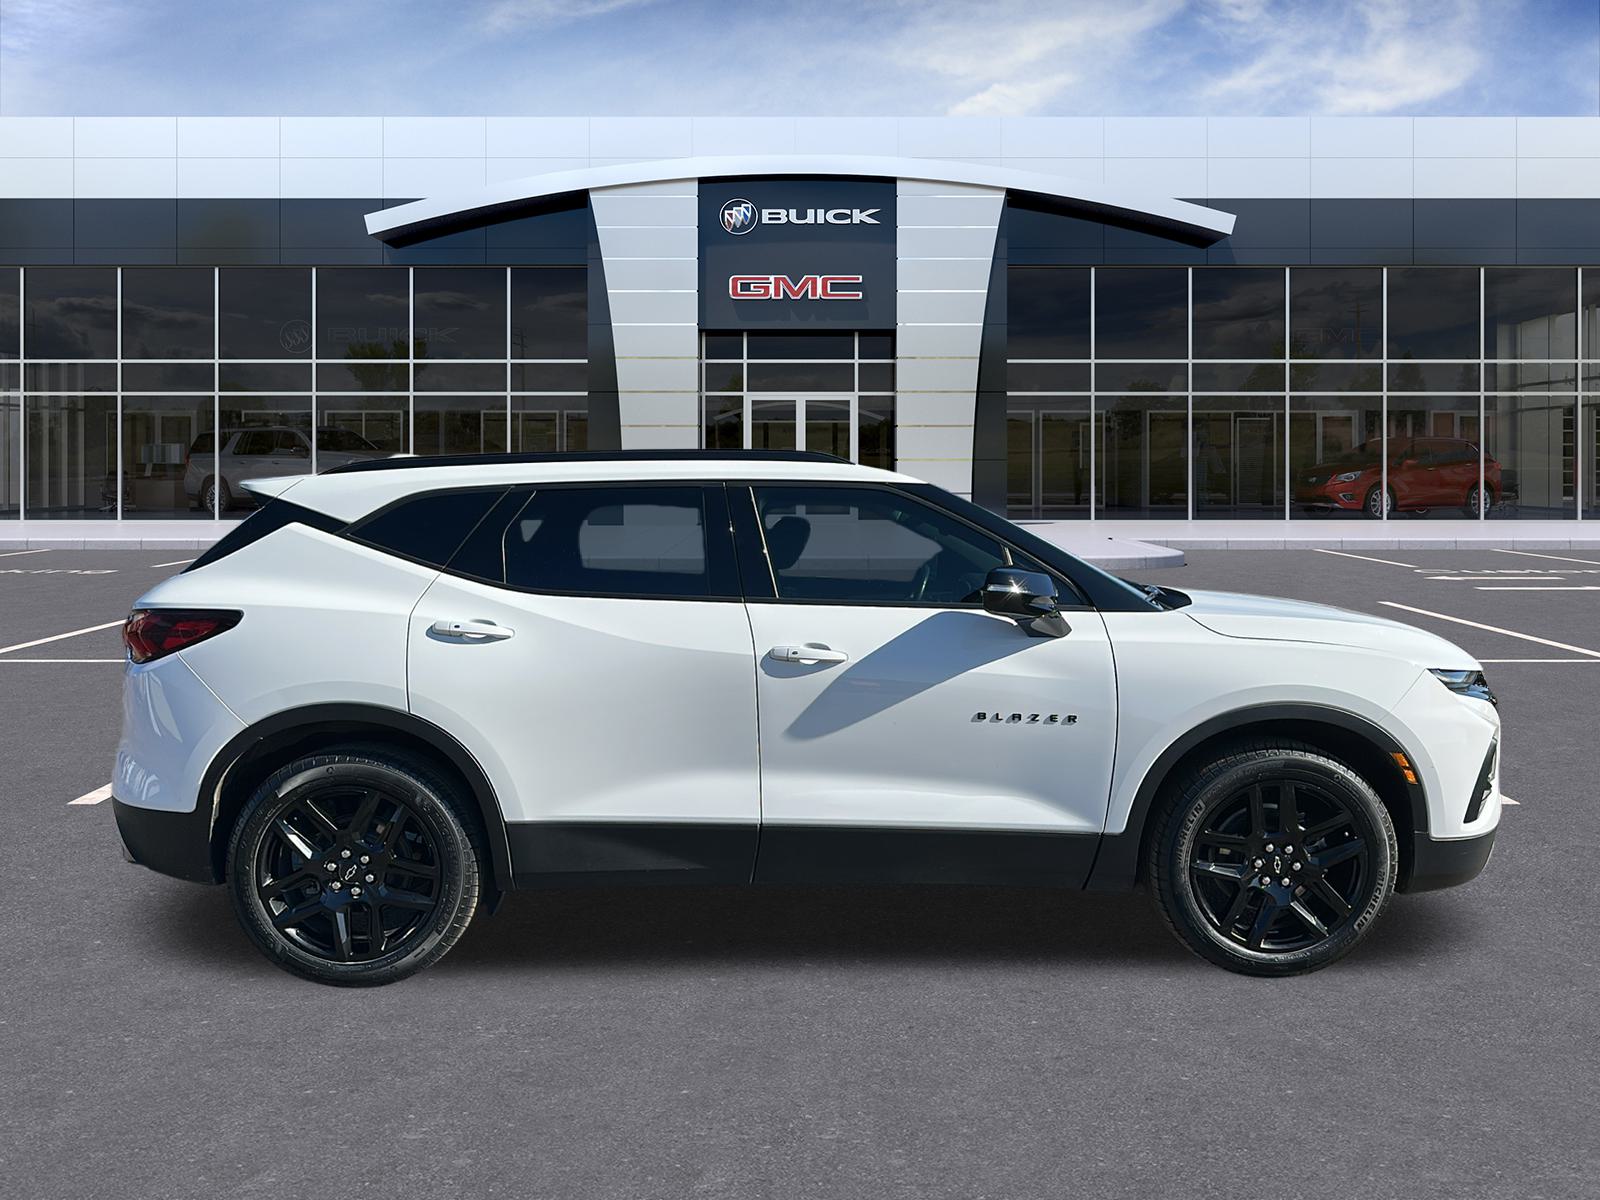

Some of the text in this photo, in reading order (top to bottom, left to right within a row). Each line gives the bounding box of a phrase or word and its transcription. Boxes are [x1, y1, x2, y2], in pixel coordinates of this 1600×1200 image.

[761, 208, 881, 225] BUICK
[729, 274, 863, 300] GMC
[972, 711, 1078, 725] BLAZER
[1357, 867, 1386, 930] MICHELIN
